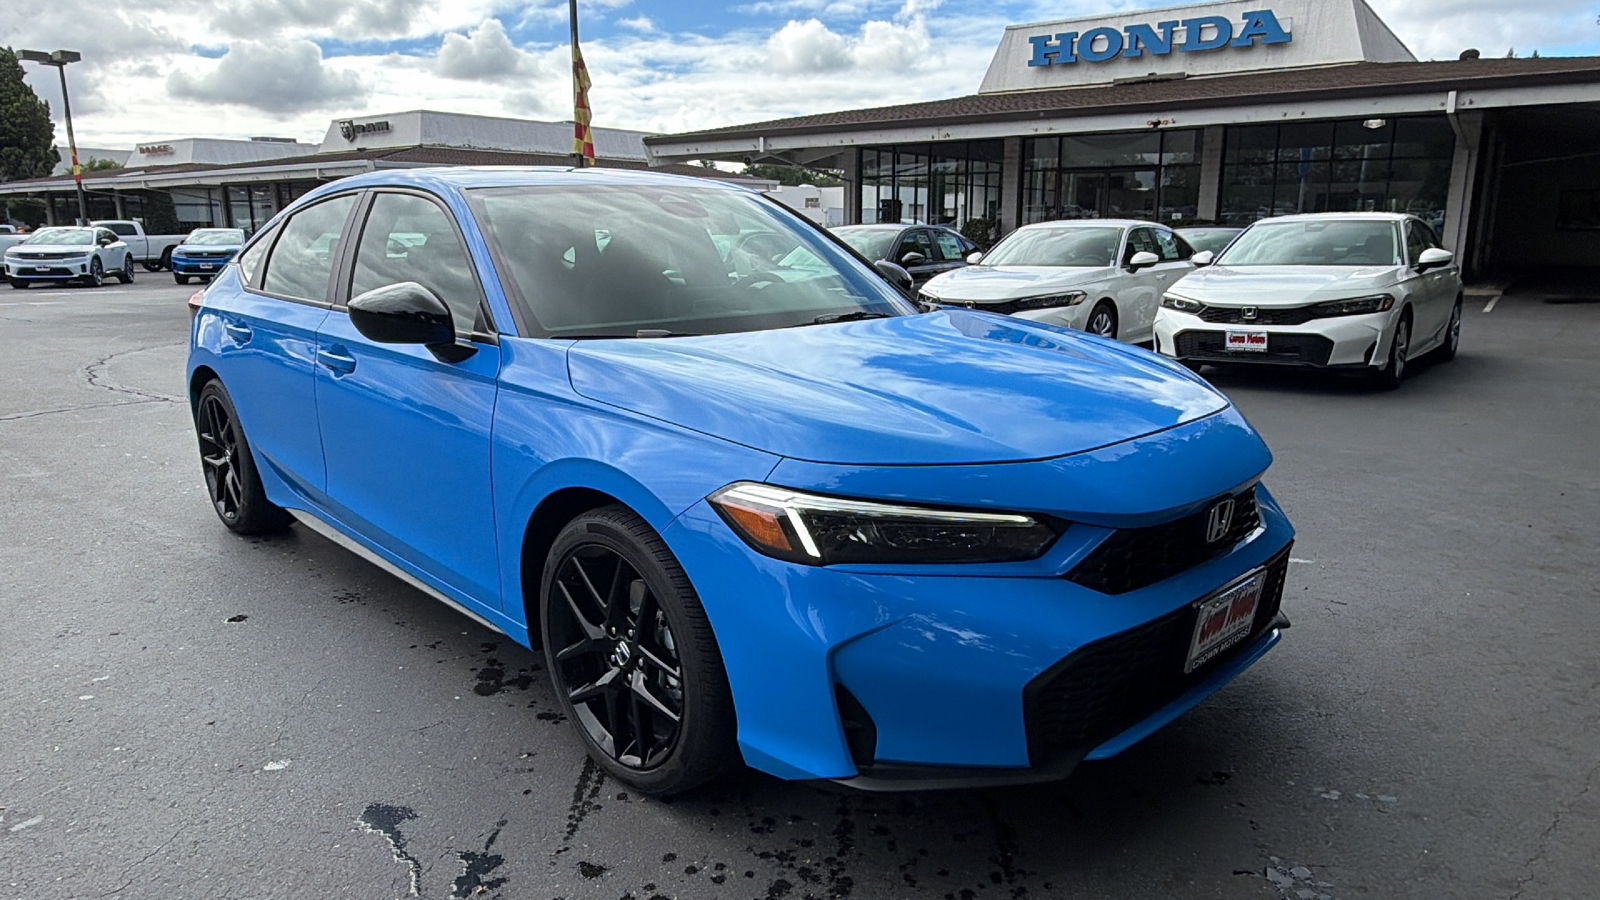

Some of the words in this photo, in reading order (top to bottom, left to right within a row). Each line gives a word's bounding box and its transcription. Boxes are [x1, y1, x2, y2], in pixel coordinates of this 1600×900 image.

[1028, 9, 1292, 67] HONDA
[354, 121, 389, 133] RAM
[1192, 648, 1220, 669] CROWN
[1219, 627, 1250, 652] MOTORS
